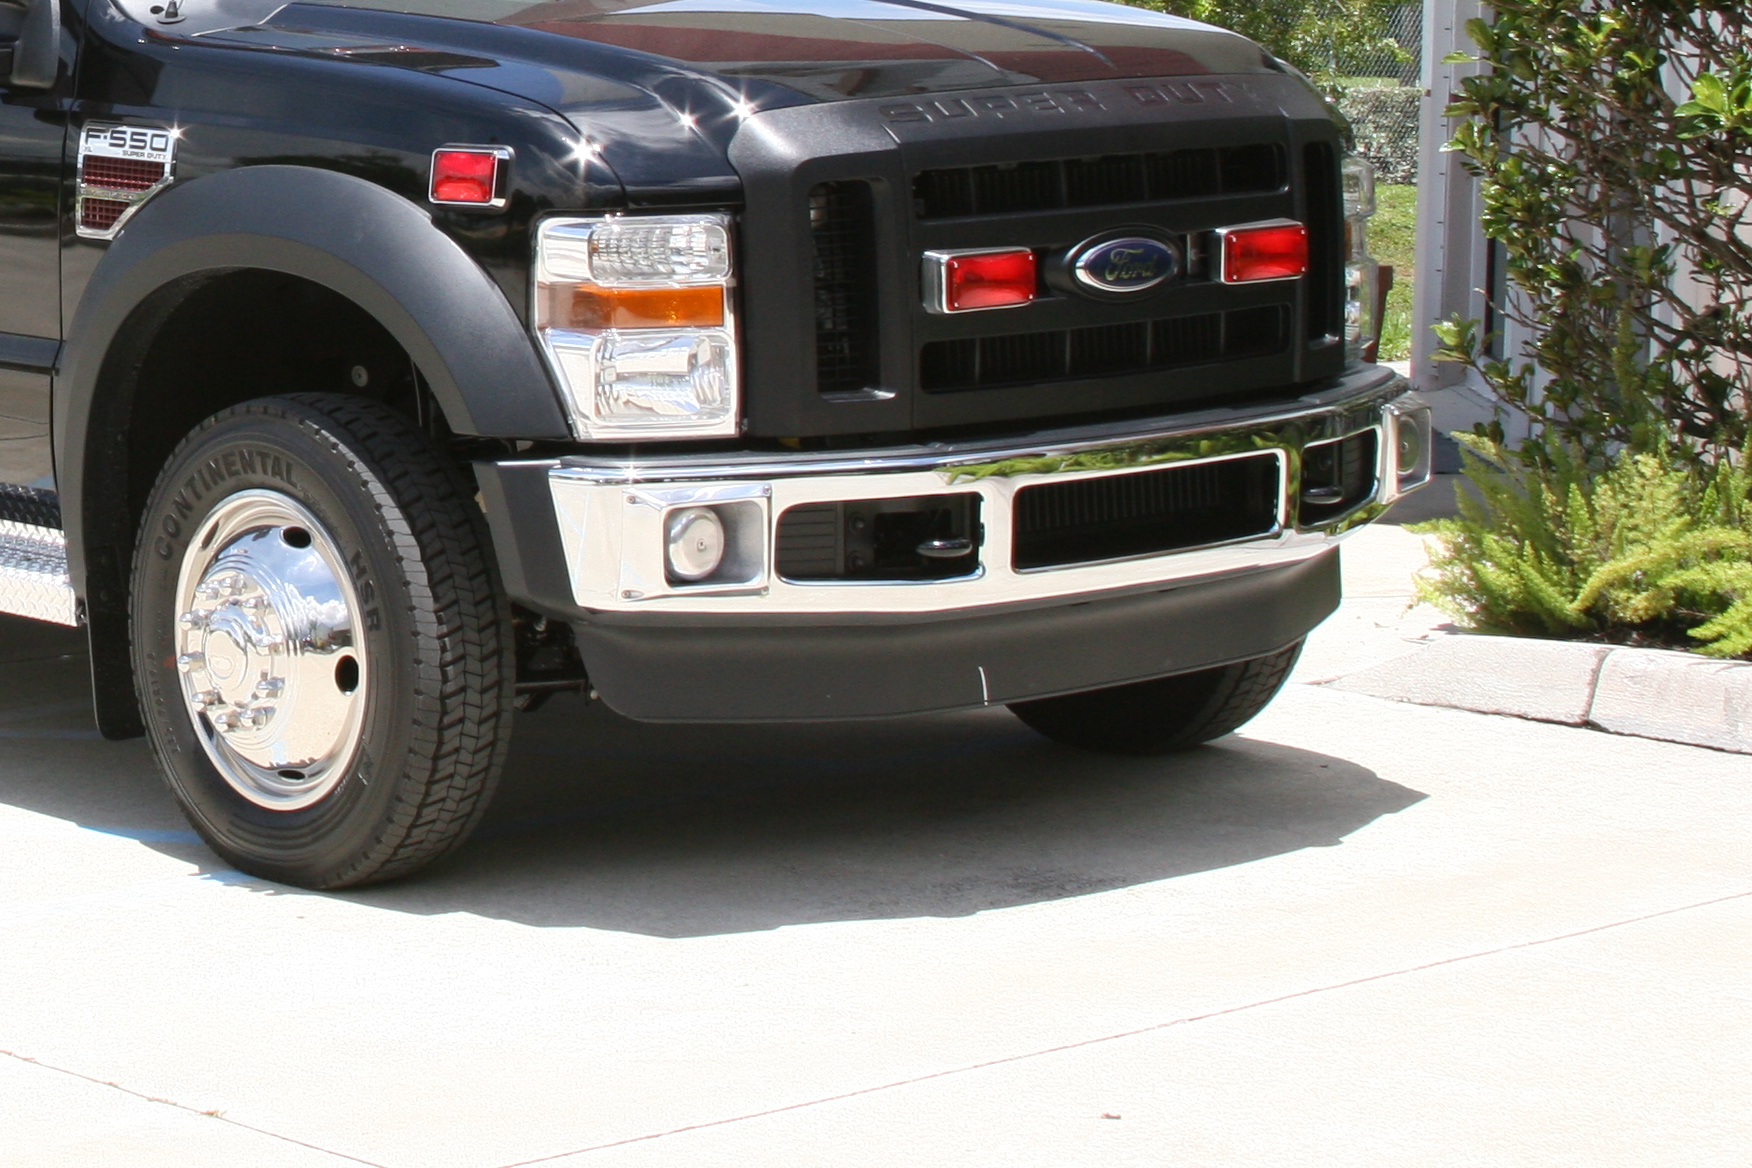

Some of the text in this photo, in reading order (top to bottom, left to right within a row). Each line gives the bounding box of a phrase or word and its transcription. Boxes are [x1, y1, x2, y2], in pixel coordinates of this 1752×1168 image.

[877, 88, 1107, 123] SUPER
[84, 127, 169, 152] F-550
[122, 150, 167, 161] SUPER DUTY
[1104, 247, 1159, 281] Ford
[154, 448, 299, 562] CONTINENTAL
